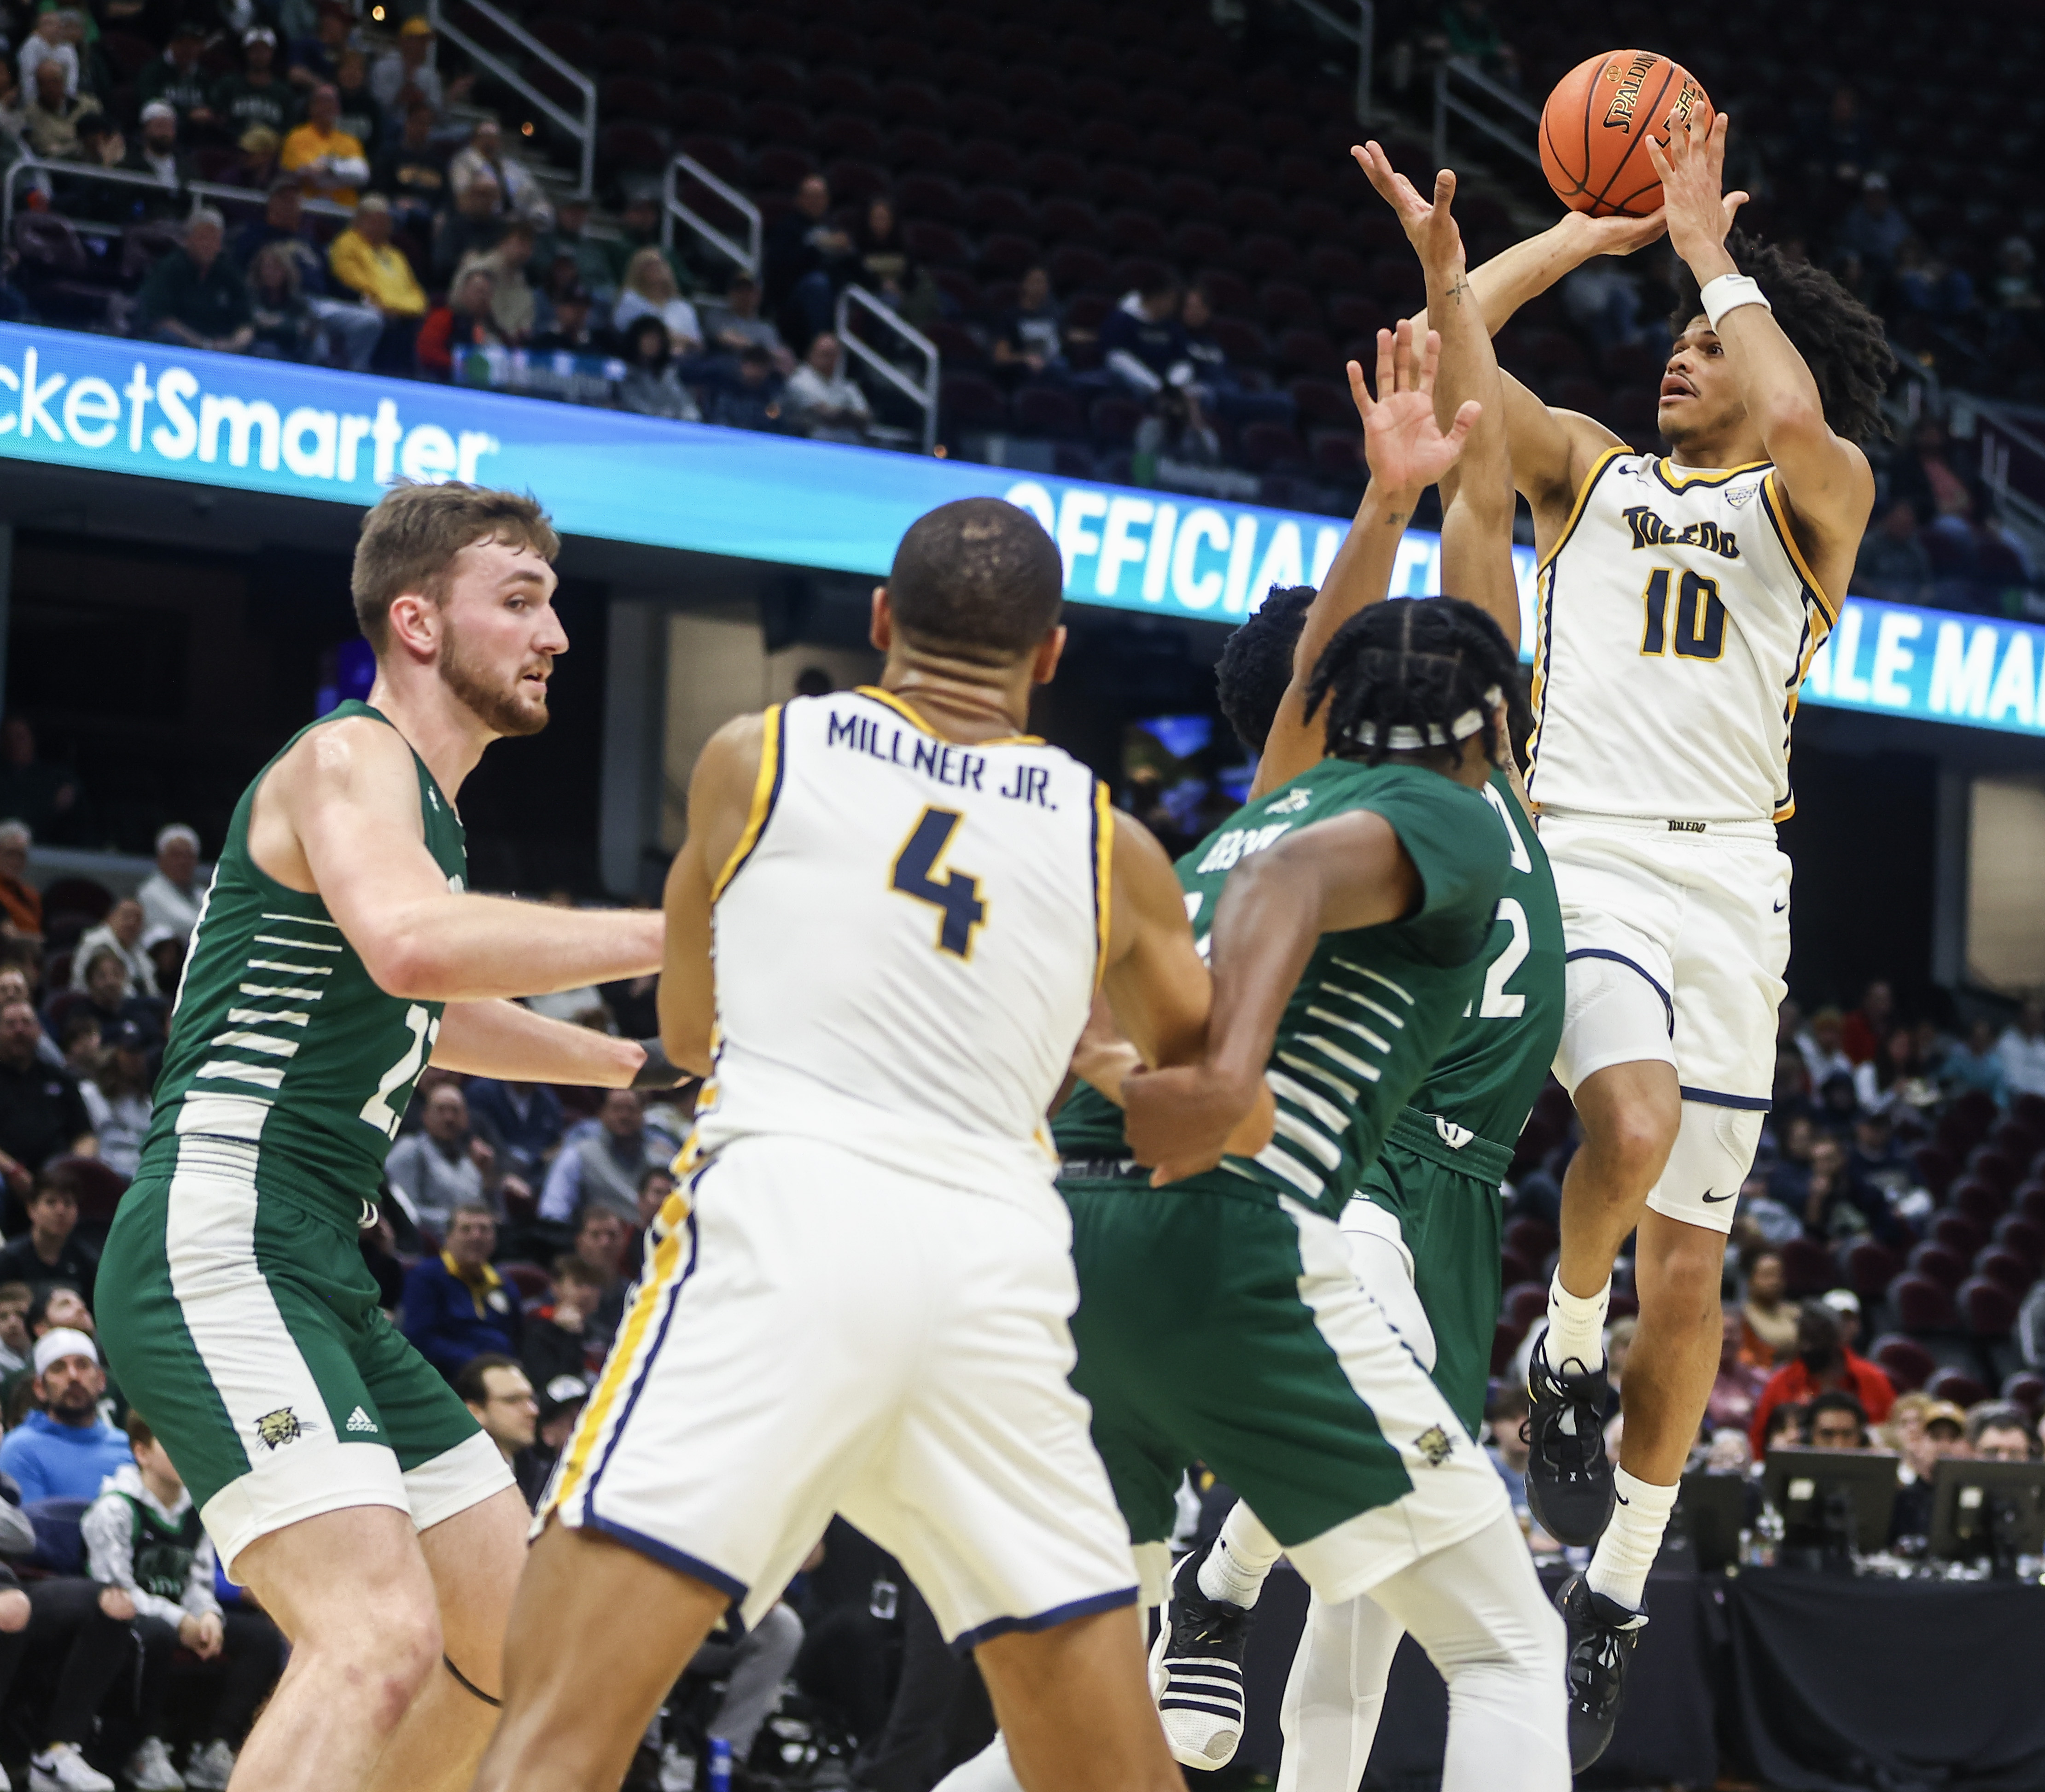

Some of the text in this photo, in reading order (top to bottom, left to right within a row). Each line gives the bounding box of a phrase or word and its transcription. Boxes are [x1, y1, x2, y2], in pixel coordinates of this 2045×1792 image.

[1602, 50, 1667, 135] SPALDIN
[1622, 505, 1741, 560] TOLEDO
[1639, 566, 1730, 663] 10
[1928, 620, 2045, 728] MA
[827, 710, 1058, 812] MILLNER JR.
[1667, 820, 1706, 833] TOLEDO
[887, 804, 990, 963] 4
[1462, 896, 1531, 1018] 2
